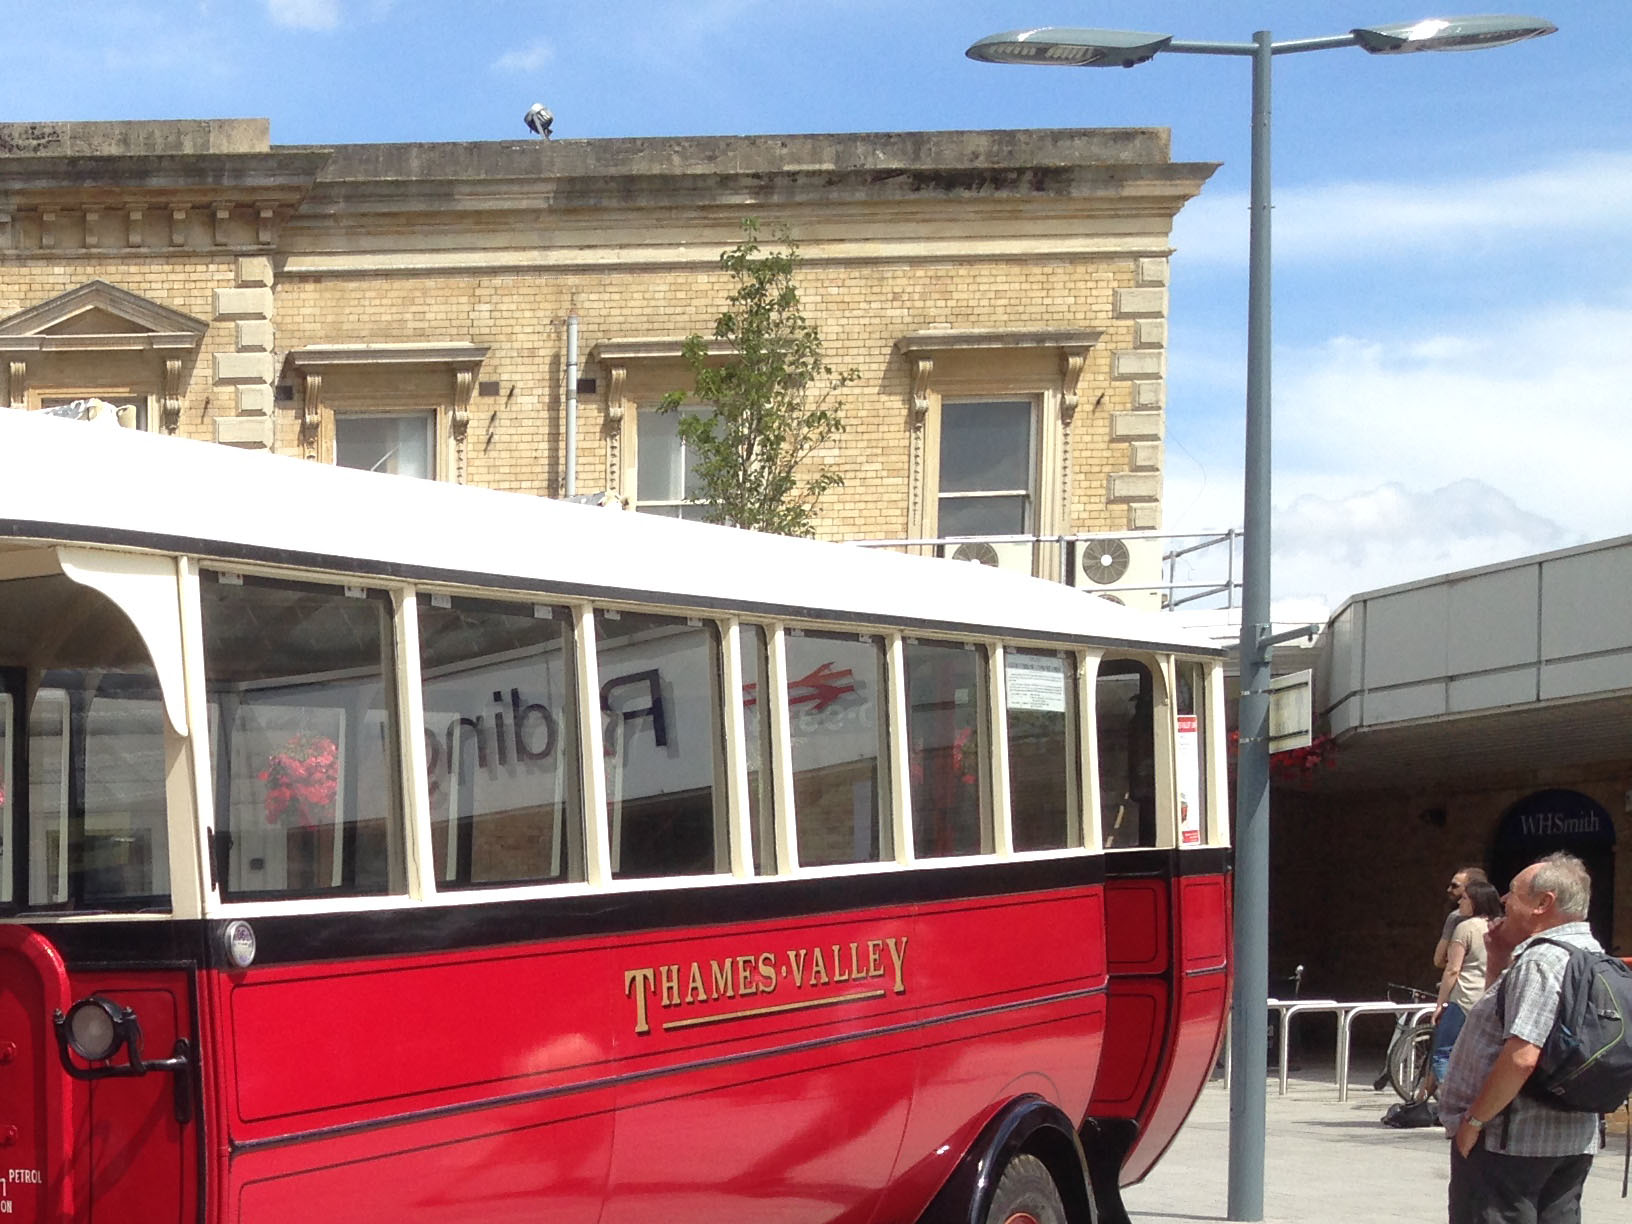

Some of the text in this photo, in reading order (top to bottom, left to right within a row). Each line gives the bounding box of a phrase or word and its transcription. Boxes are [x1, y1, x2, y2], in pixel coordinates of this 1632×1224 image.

[1520, 810, 1600, 836] WHSmith
[8, 1169, 43, 1184] PETROL
[0, 1200, 13, 1213] ON
